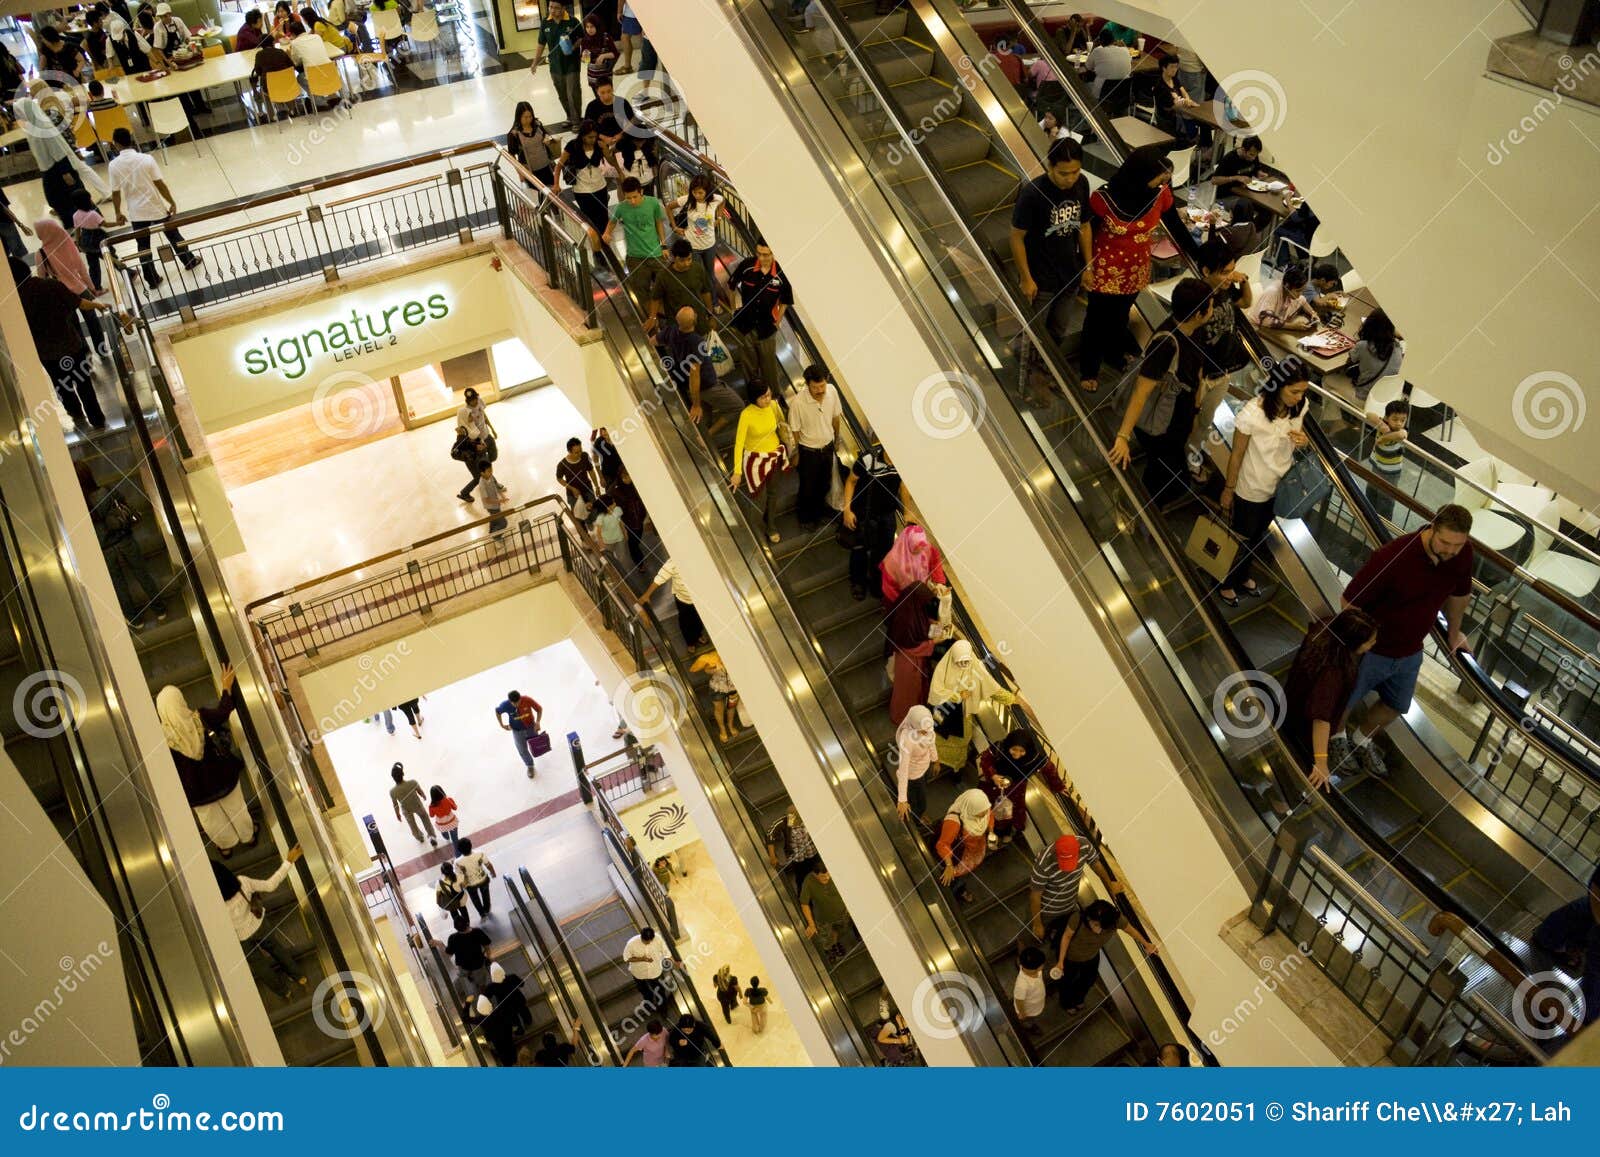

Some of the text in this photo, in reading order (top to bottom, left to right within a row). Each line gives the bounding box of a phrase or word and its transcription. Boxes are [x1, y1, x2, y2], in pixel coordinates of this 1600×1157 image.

[1053, 205, 1080, 226] 1985
[244, 293, 450, 379] signatures
[333, 334, 398, 363] LEVEL 2
